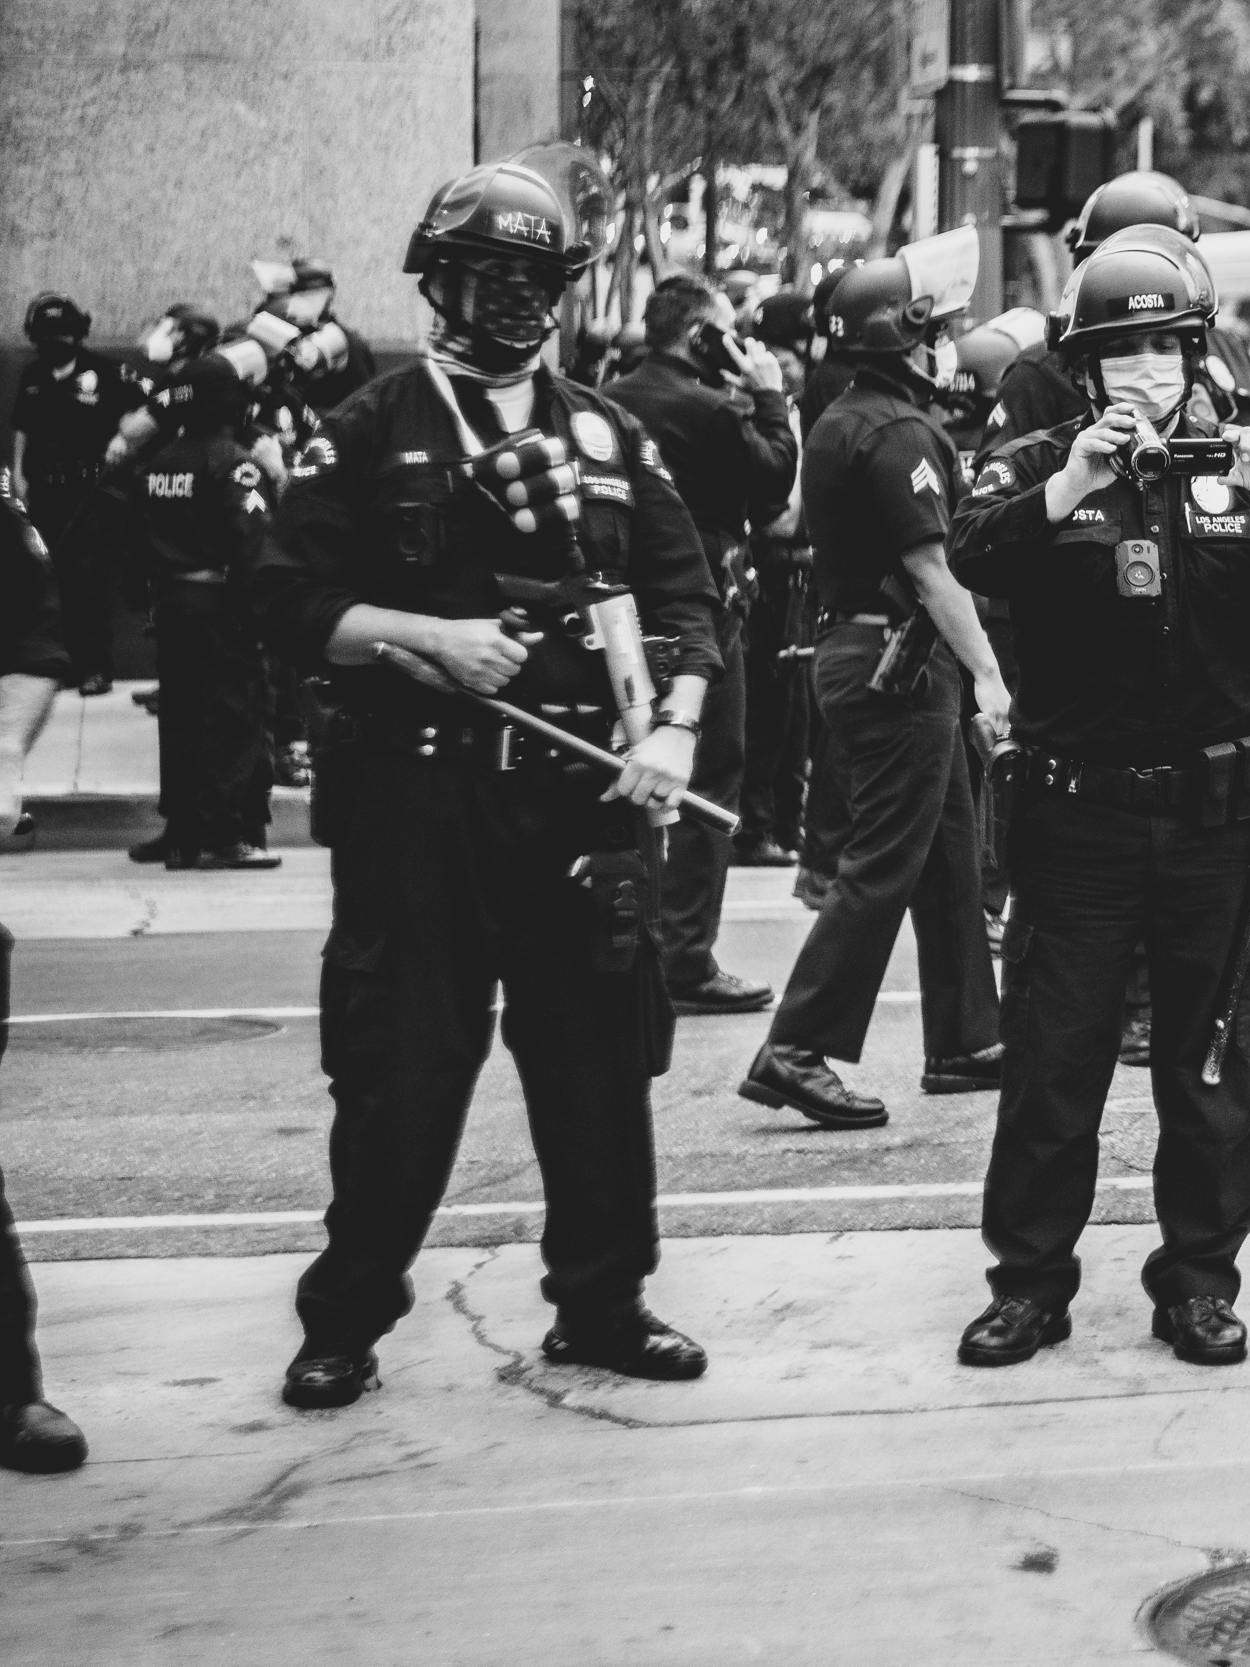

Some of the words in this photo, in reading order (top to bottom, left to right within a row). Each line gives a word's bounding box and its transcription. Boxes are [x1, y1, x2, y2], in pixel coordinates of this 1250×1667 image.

[498, 212, 551, 244] MATA
[1128, 294, 1165, 310] ACOSTA
[405, 451, 428, 464] MATA
[148, 472, 194, 498] POLICE
[593, 485, 628, 501] POLICE
[1195, 516, 1211, 524] LOS
[1212, 516, 1246, 524] ANGELES
[1204, 523, 1243, 533] POLICE
